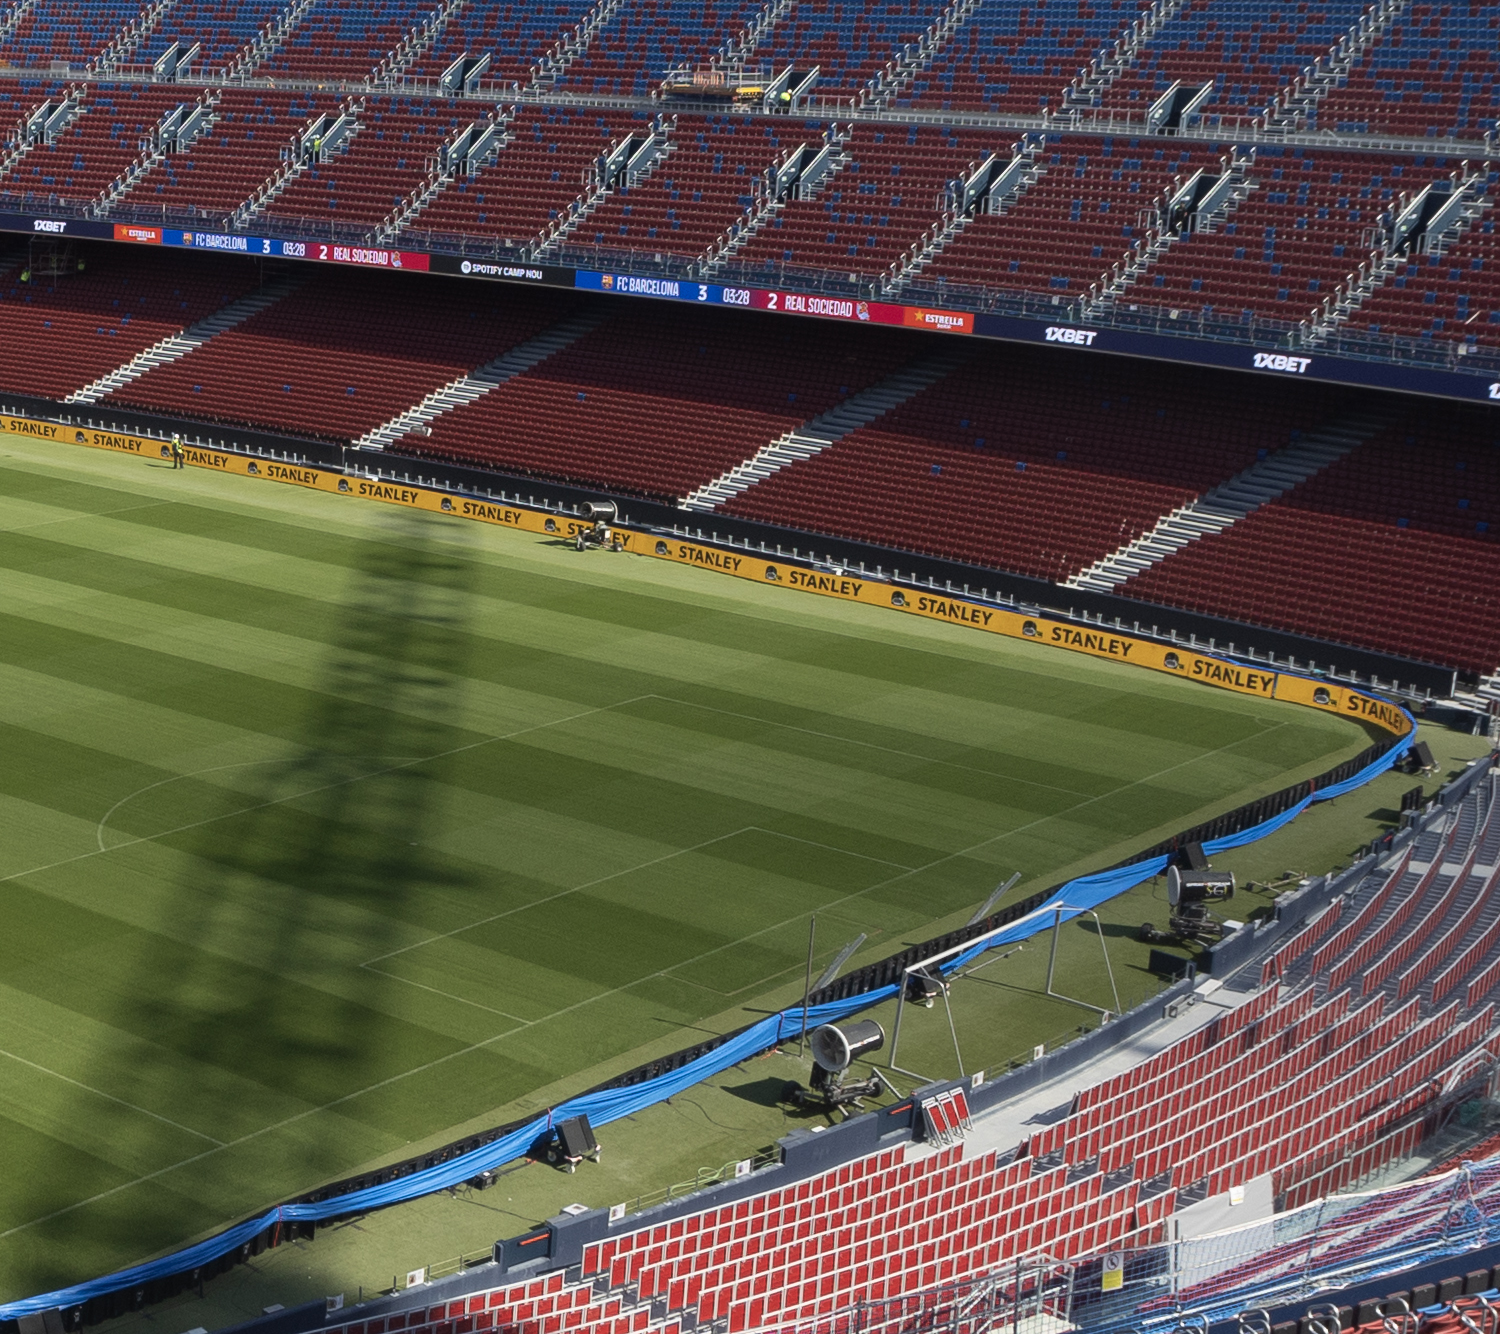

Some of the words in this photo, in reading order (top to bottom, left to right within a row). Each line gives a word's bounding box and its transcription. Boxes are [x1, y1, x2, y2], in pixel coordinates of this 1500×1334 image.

[34, 219, 66, 233] 1XBET
[195, 232, 206, 246] FC
[206, 233, 248, 251] BARCELONA
[262, 239, 271, 254] 3
[282, 242, 306, 257] 03:28
[318, 244, 328, 260] 2
[333, 246, 352, 262] REAL
[352, 248, 388, 266] SOCIEDAD
[471, 263, 502, 276] SPOTIFY
[503, 266, 524, 279] CAMP
[525, 268, 543, 280] NOU
[616, 276, 628, 291] FC
[629, 277, 679, 297] BARCELONA
[697, 285, 708, 301] 3
[722, 287, 750, 306] 03:28
[767, 293, 778, 310] 2
[784, 295, 807, 312] REAL
[808, 298, 853, 318] SOCIEDAD
[925, 313, 963, 327] ESTRELLA
[1045, 326, 1097, 346] 1XBET
[1253, 352, 1311, 373] 1XBET
[10, 420, 58, 438] STANLEY
[93, 433, 142, 452] STANLEY
[267, 465, 319, 485] STANLEY
[359, 482, 419, 504] STANLEY
[463, 501, 522, 525] STANLEY
[678, 545, 742, 572] STANLEY
[789, 570, 863, 597] STANLEY
[917, 596, 993, 626] STANLEY
[1051, 626, 1133, 657] STANLEY
[1192, 659, 1273, 693] STANLEY
